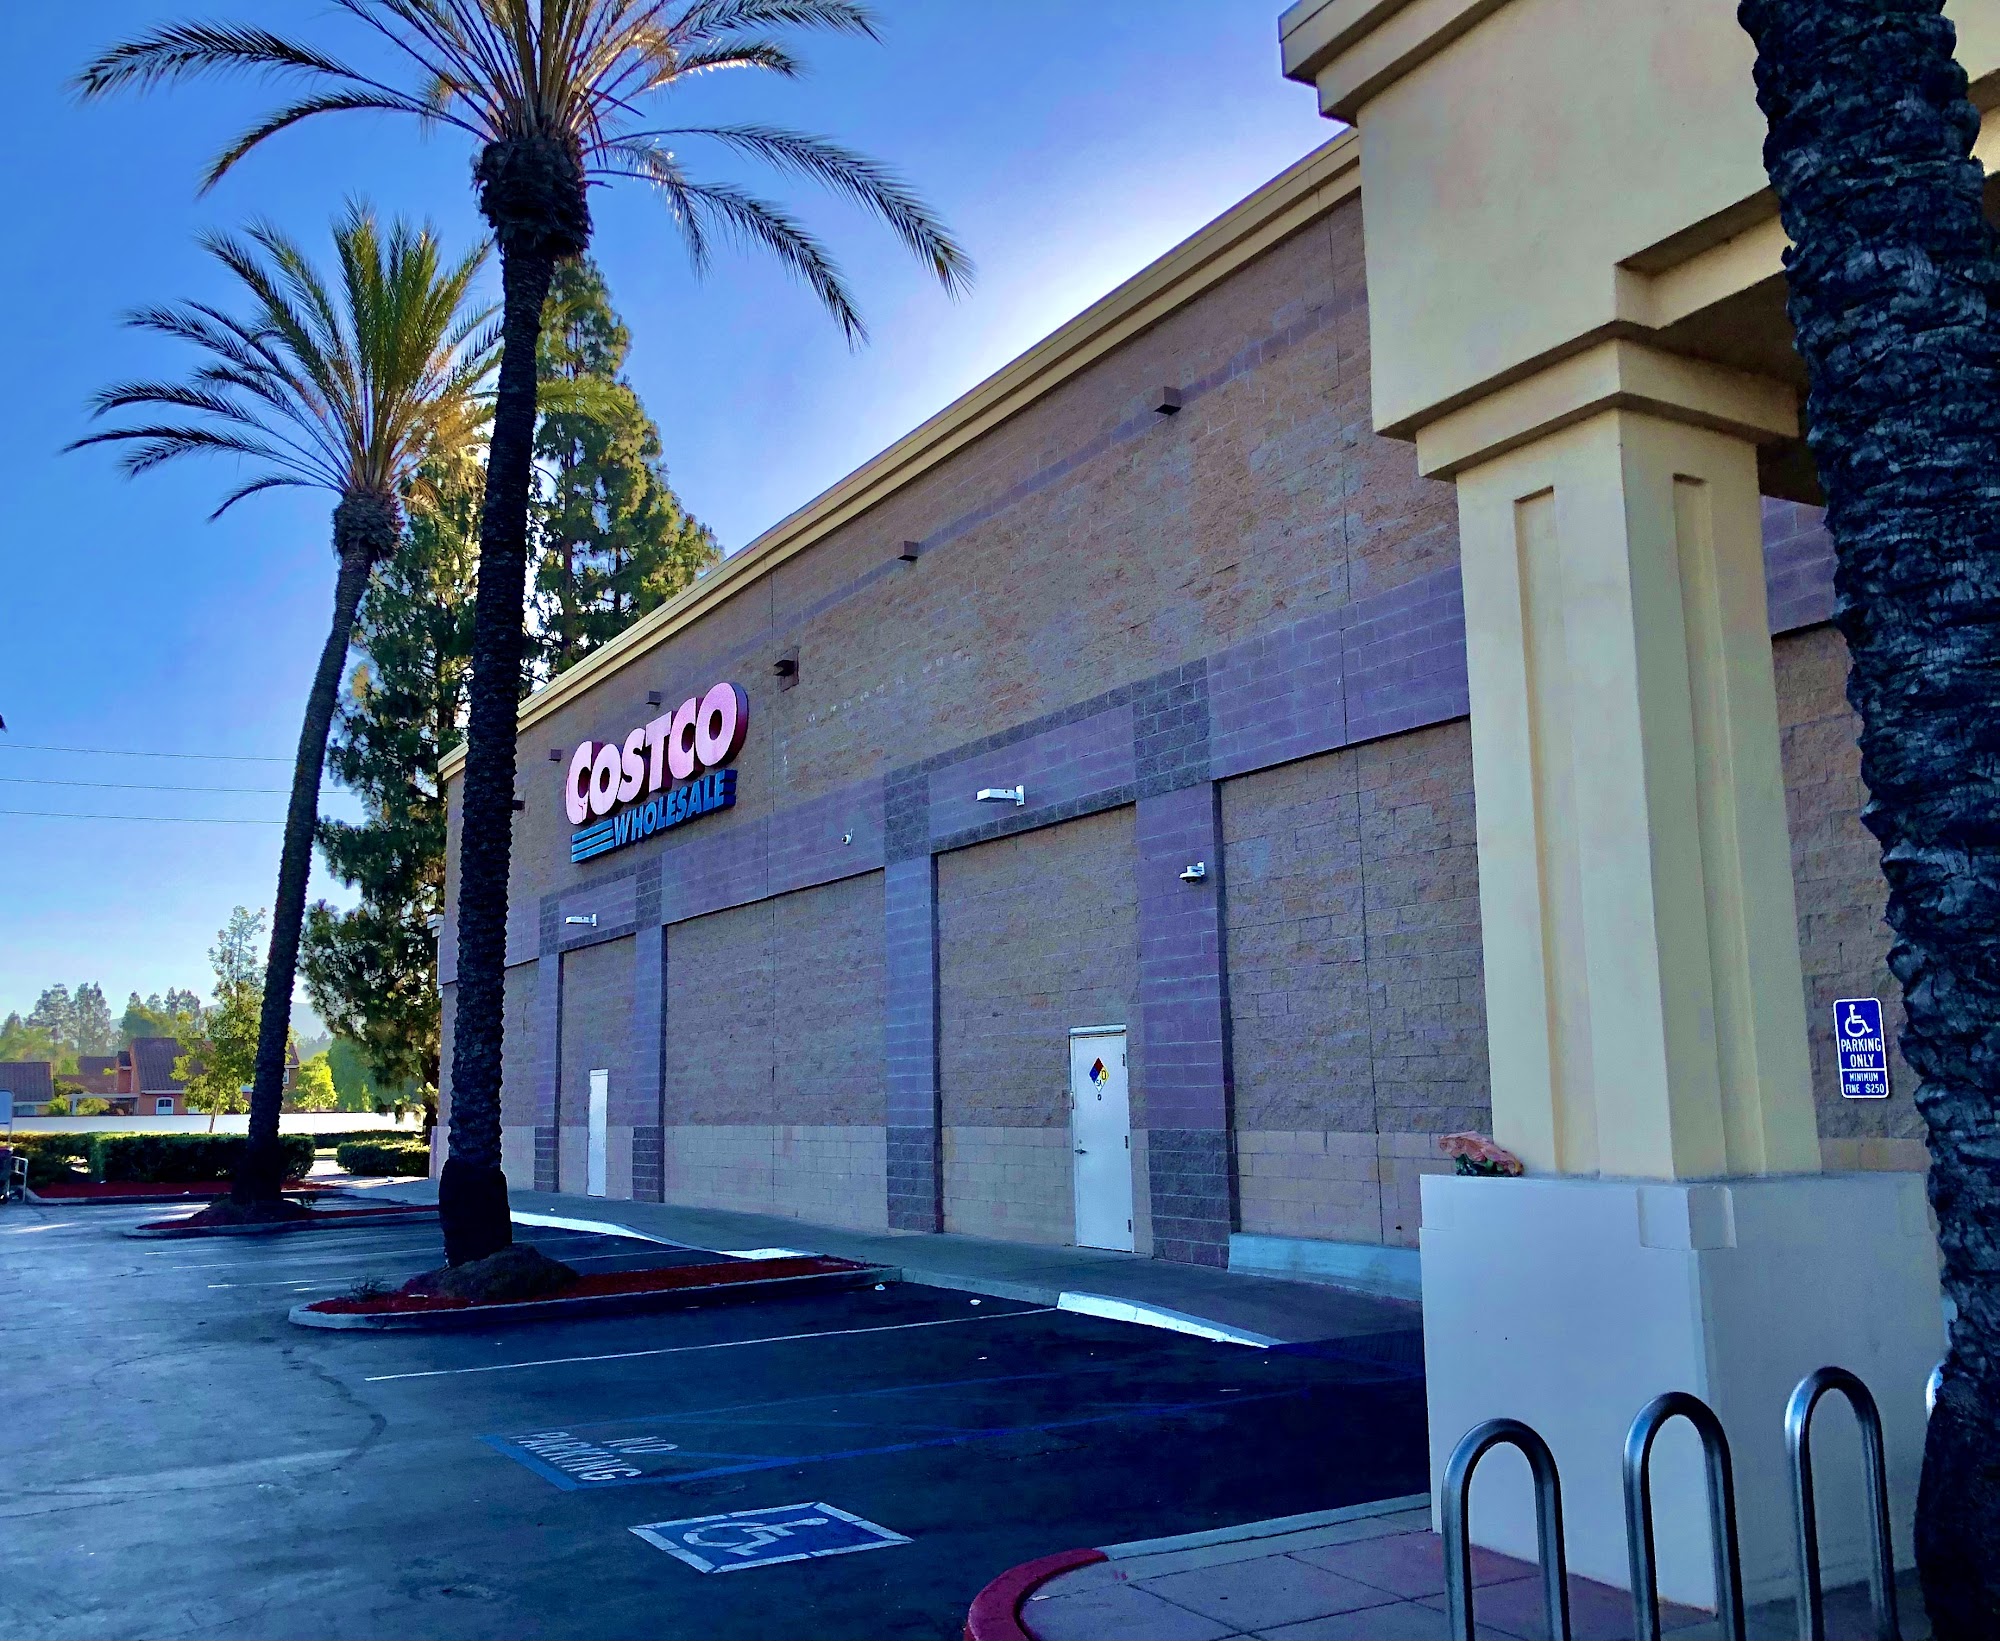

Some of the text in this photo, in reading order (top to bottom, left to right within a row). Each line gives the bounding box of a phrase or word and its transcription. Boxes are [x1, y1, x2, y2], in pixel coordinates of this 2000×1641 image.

[566, 682, 742, 825] COSTCO
[614, 769, 730, 847] WHOLESALE
[1841, 1037, 1881, 1052] PARKING
[1850, 1053, 1874, 1067] ONLY
[1849, 1072, 1879, 1082] MINIMUM
[1845, 1083, 1885, 1093] FINE $250
[601, 1435, 679, 1454] NO
[508, 1431, 642, 1481] PARKING
